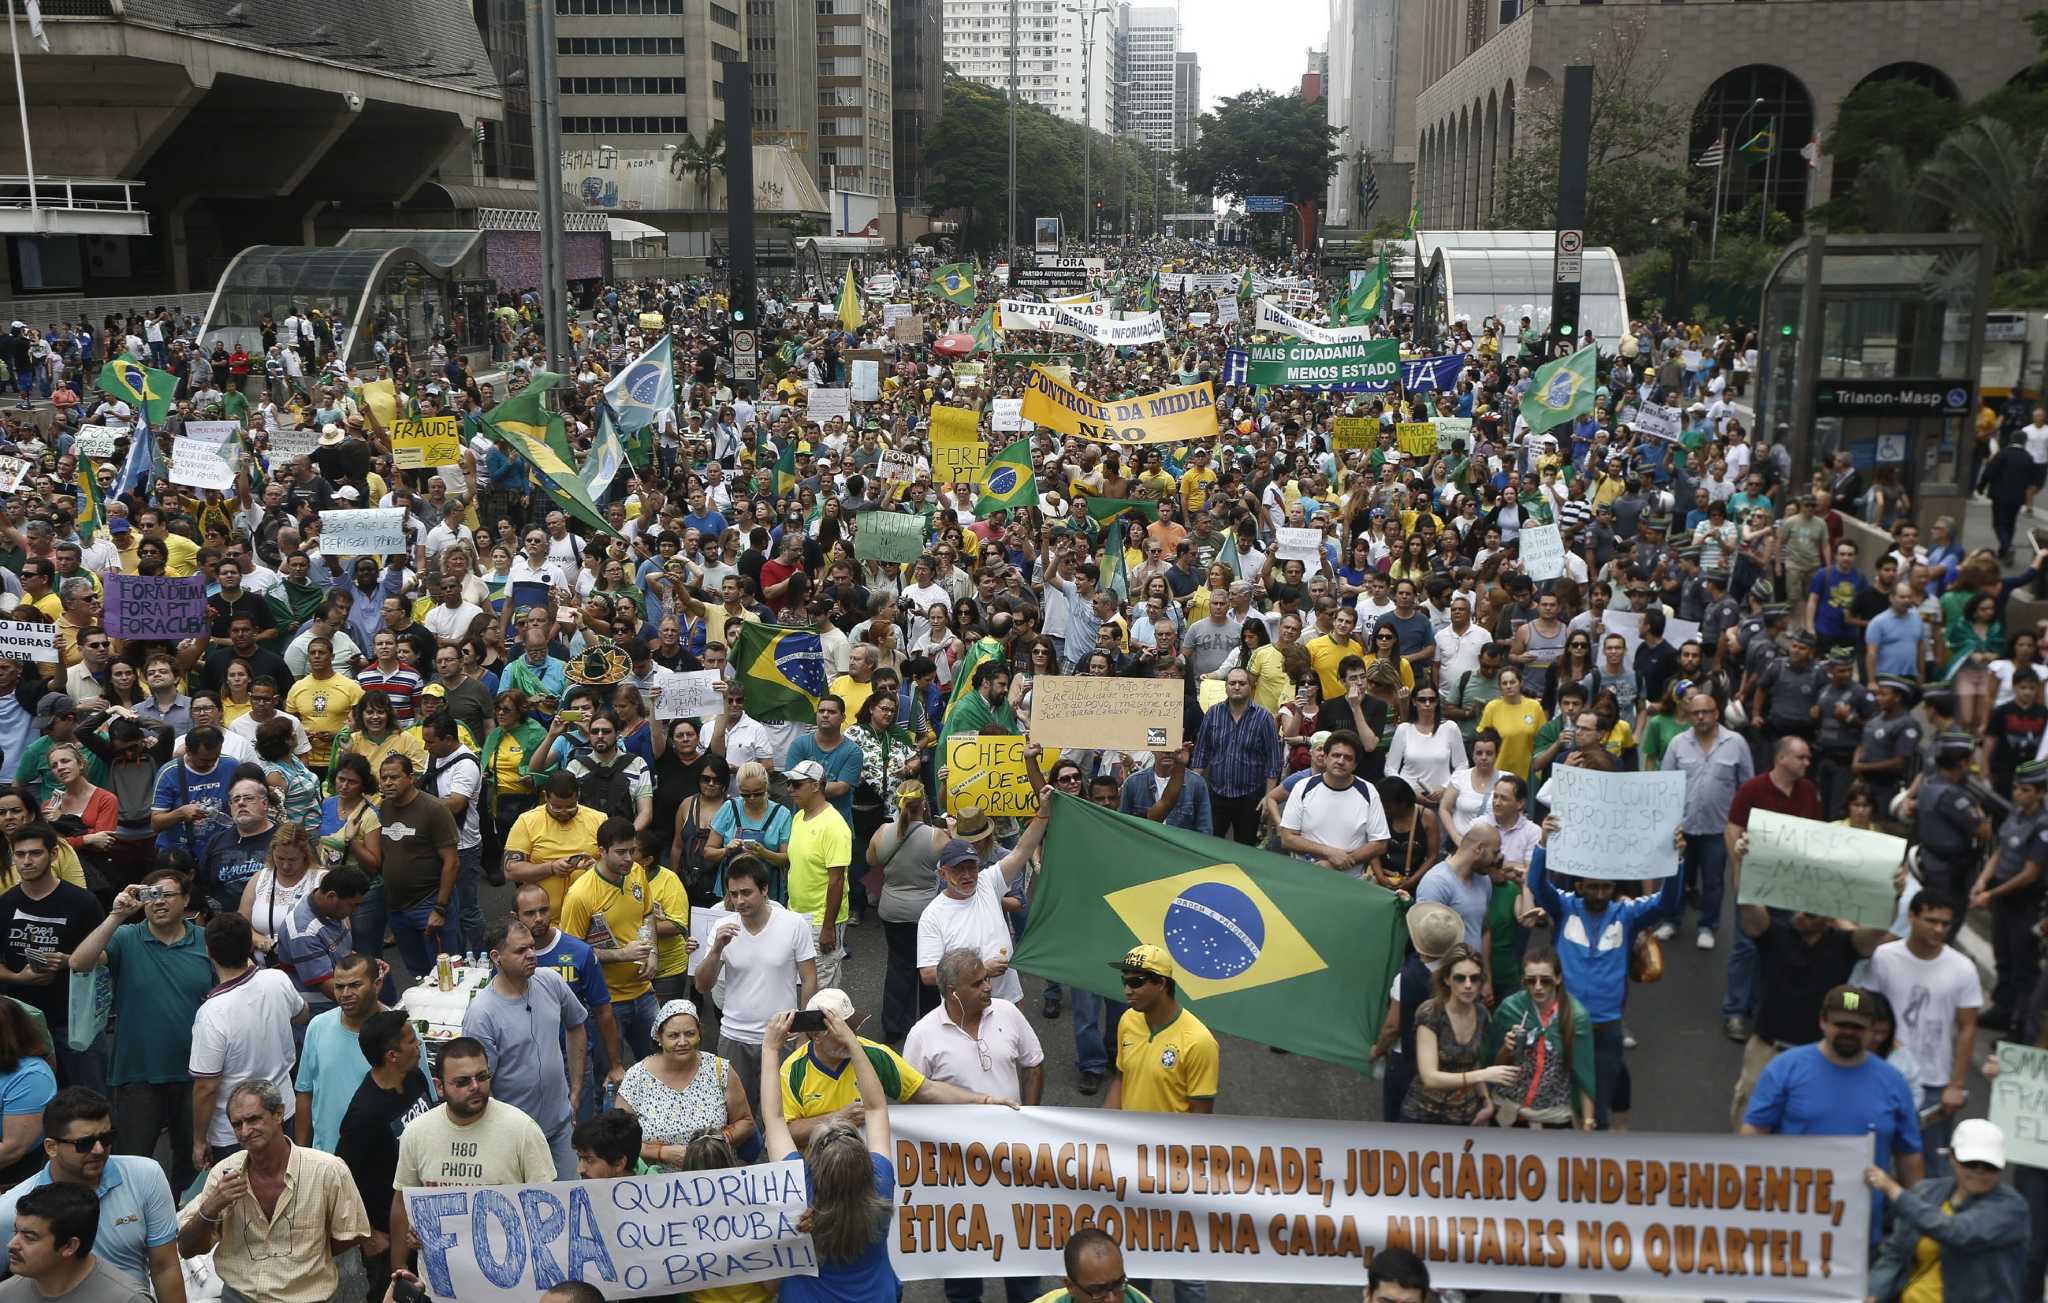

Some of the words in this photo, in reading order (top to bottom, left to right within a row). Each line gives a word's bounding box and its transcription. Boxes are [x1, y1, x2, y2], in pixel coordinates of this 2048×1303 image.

[1056, 258, 1085, 267] FORA
[1055, 310, 1098, 337] LIBERDADE
[1111, 317, 1161, 340] INFORMAÇÃO
[1252, 346, 1286, 361] MAIS
[1290, 344, 1366, 362] CIDADANIA
[1287, 365, 1339, 380] MENOS
[1341, 361, 1397, 378] ESTADO
[1026, 368, 1111, 422] CONTROLE
[1115, 403, 1144, 421] DA
[1148, 387, 1213, 418] MIDIA
[1836, 389, 1942, 407] Trianon-Masp
[393, 420, 457, 440] FRAUDE
[1077, 420, 1146, 442] NÃO
[885, 451, 912, 463] FORA
[936, 446, 987, 465] FORA
[951, 466, 980, 483] PT
[120, 583, 164, 600] FORA
[167, 582, 207, 600] DILMA
[120, 600, 164, 617] FORA
[167, 601, 192, 618] PT
[16, 622, 33, 633] DA
[36, 623, 56, 634] LEI
[120, 617, 164, 634] FORA
[988, 770, 1014, 790] DE
[1639, 809, 1665, 831] SP
[24, 923, 54, 937] FORA
[1176, 898, 1206, 913] ORDEM
[1218, 916, 1259, 955] PROGRESSO
[400, 1096, 430, 1127] FORA
[441, 1162, 483, 1178] PHOTO
[896, 1139, 1127, 1201] DEMOCRACIA,
[1136, 1143, 1335, 1208] LIBERDADE,
[1344, 1138, 1547, 1202] JUDICIÁRIO
[1558, 1156, 1846, 1227] INDEPENDENTE,
[410, 1185, 618, 1299] FORA
[611, 1168, 804, 1212] QUADRILHA
[616, 1219, 690, 1251] QUE
[694, 1210, 799, 1245] ROUBA
[899, 1189, 1004, 1262] ÉTICA,
[1011, 1202, 1200, 1252] VERGONHA
[1208, 1210, 1261, 1254] NA
[1268, 1212, 1375, 1269] CARA,
[1386, 1215, 1567, 1268] MILITARES
[1577, 1219, 1633, 1271] NO
[1643, 1222, 1808, 1278] QUARTEL
[624, 1264, 648, 1290] O
